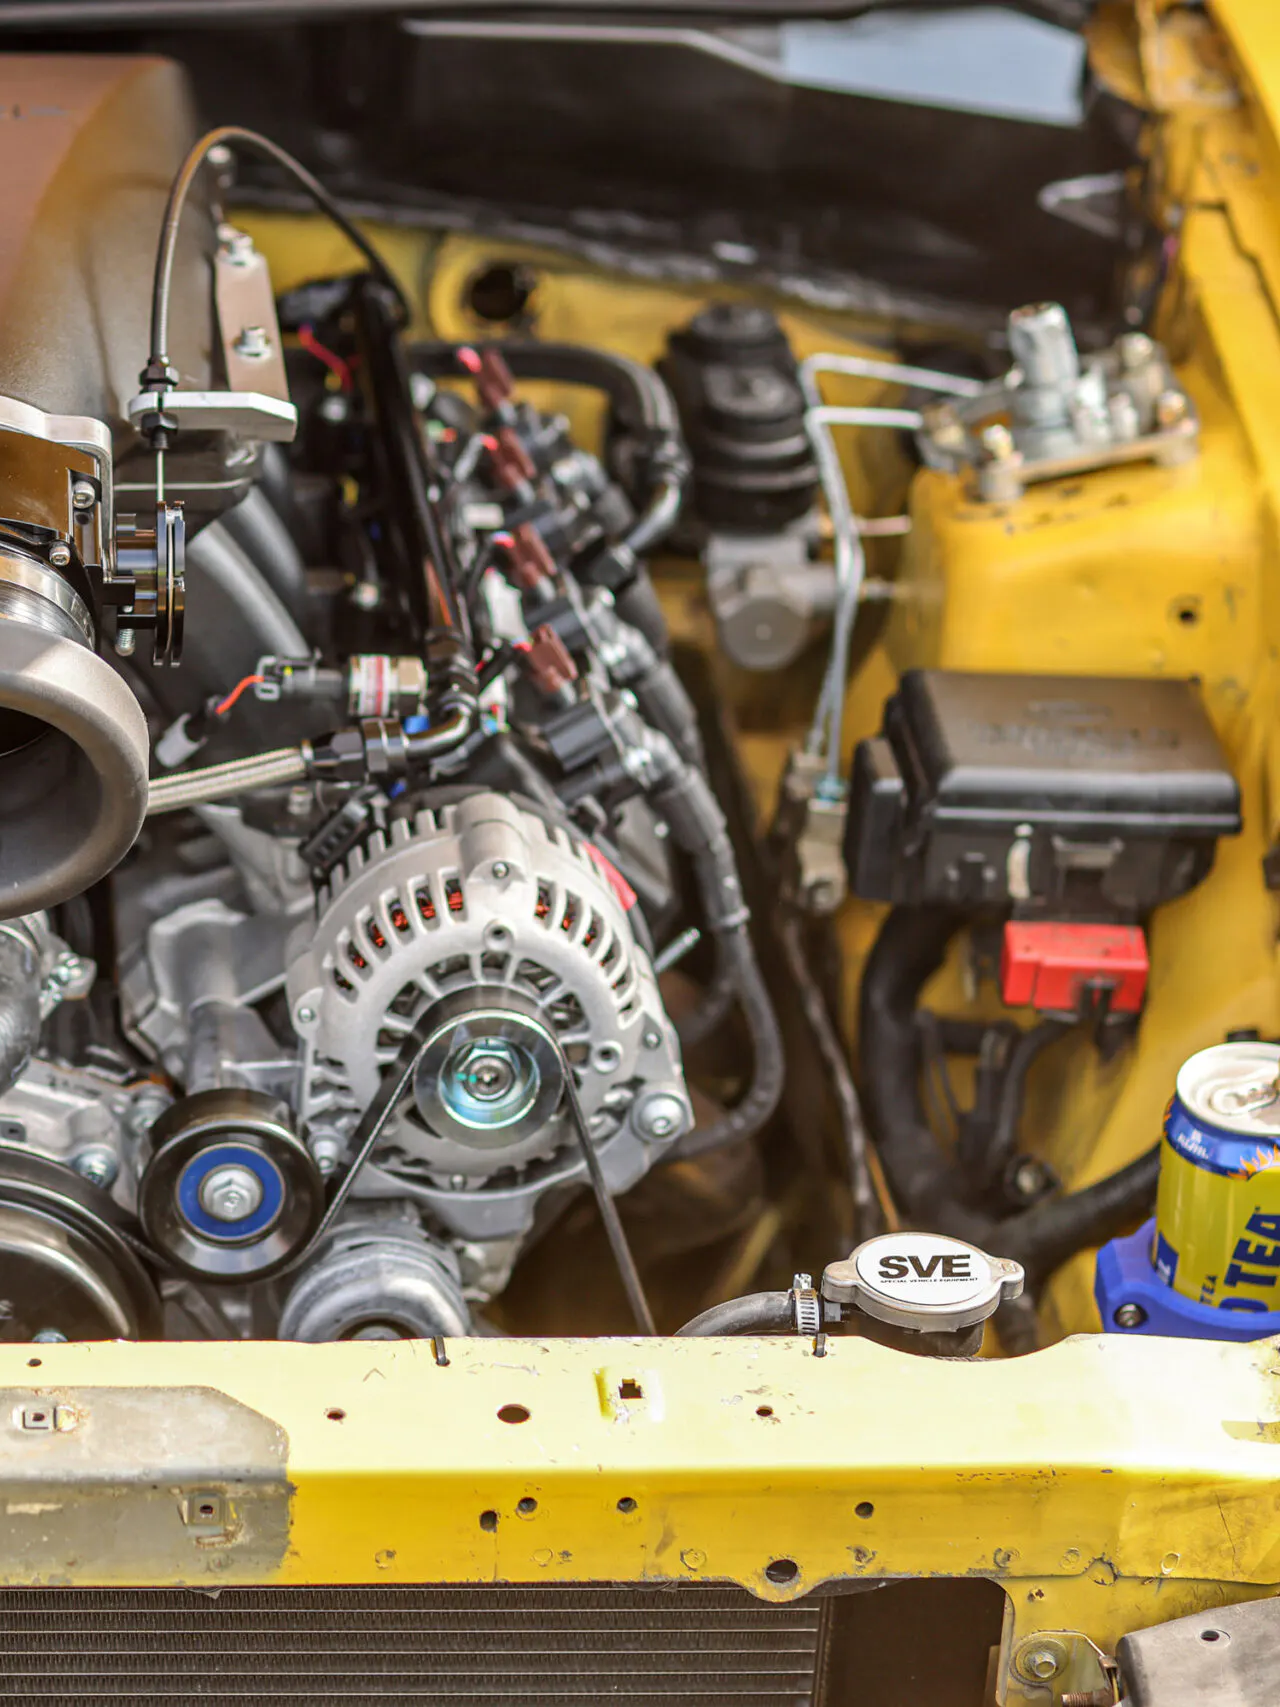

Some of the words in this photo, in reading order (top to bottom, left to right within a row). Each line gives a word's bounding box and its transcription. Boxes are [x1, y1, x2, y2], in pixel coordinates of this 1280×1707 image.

[1223, 1212, 1280, 1288] TEA
[878, 1254, 971, 1279] SVE
[1199, 1274, 1219, 1304] TEA
